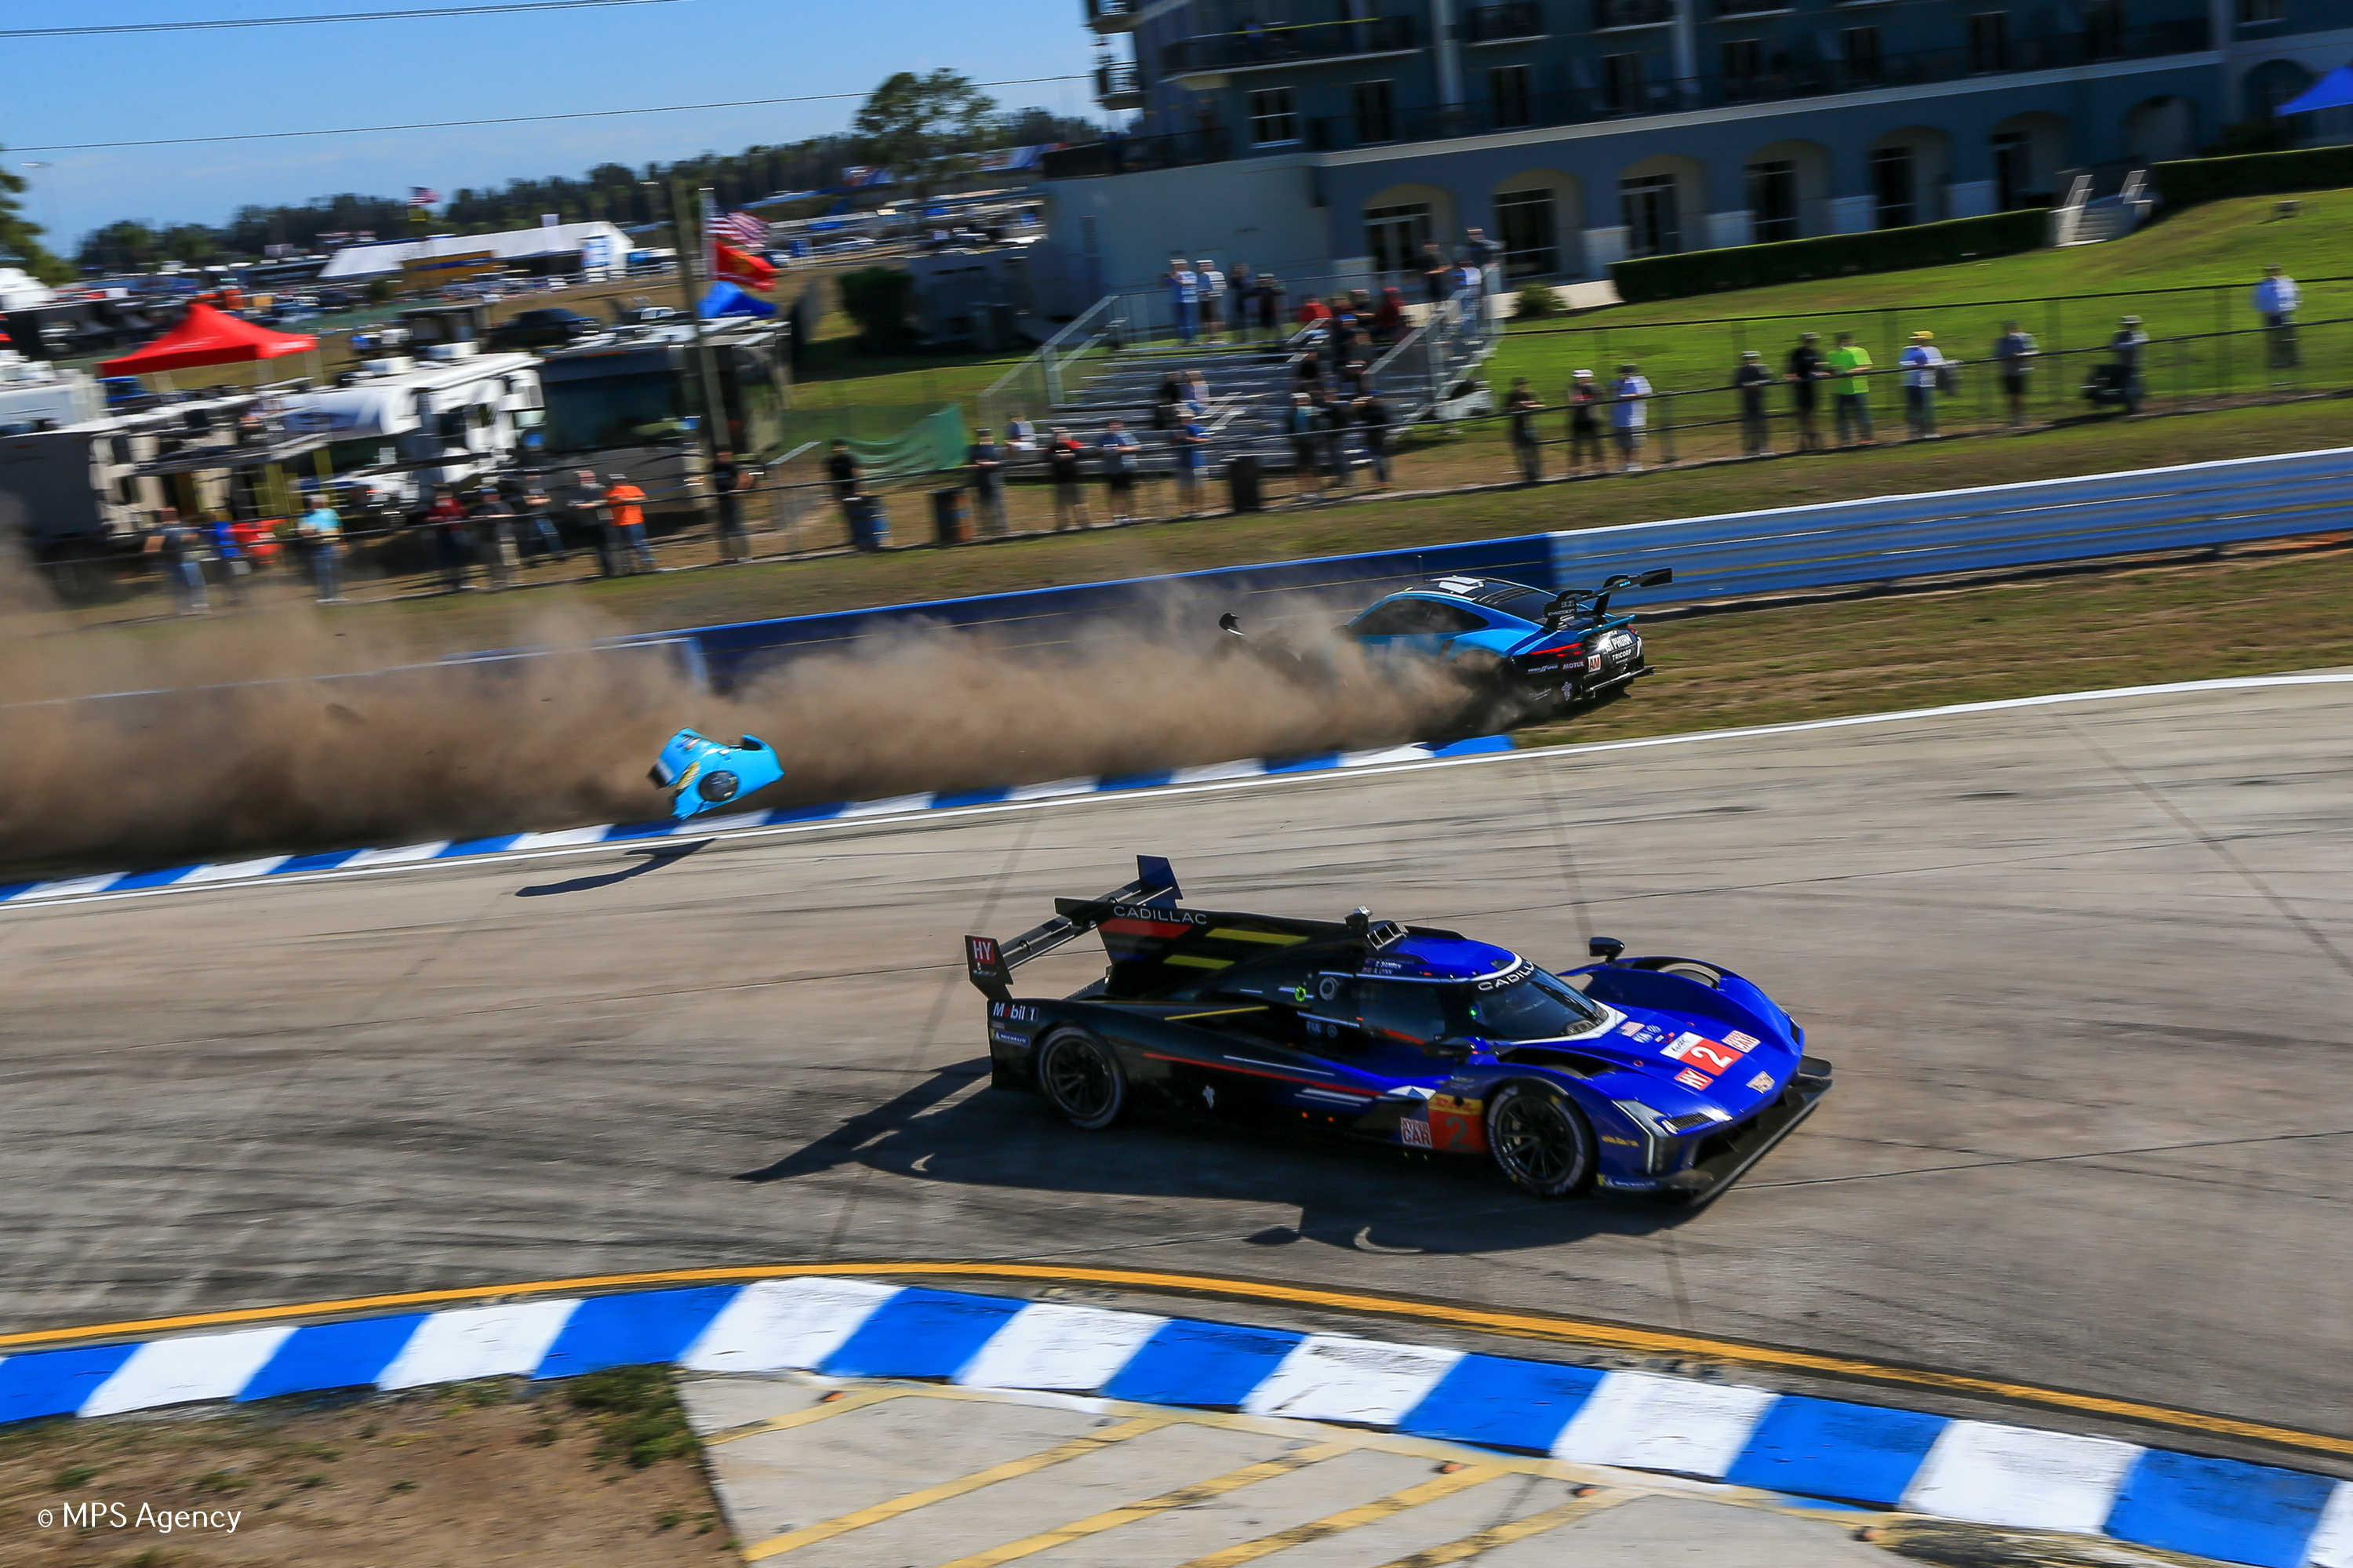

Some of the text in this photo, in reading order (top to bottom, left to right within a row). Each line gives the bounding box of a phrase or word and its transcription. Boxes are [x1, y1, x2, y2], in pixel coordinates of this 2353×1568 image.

[1590, 657, 1599, 669] AM
[1612, 649, 1631, 661] TRICORP
[1114, 905, 1207, 924] CADILLAC
[973, 940, 991, 960] HY
[993, 1002, 1026, 1020] Mobil
[1690, 1046, 1733, 1068] 2
[1677, 1070, 1708, 1090] HY
[1446, 1116, 1472, 1148] 2
